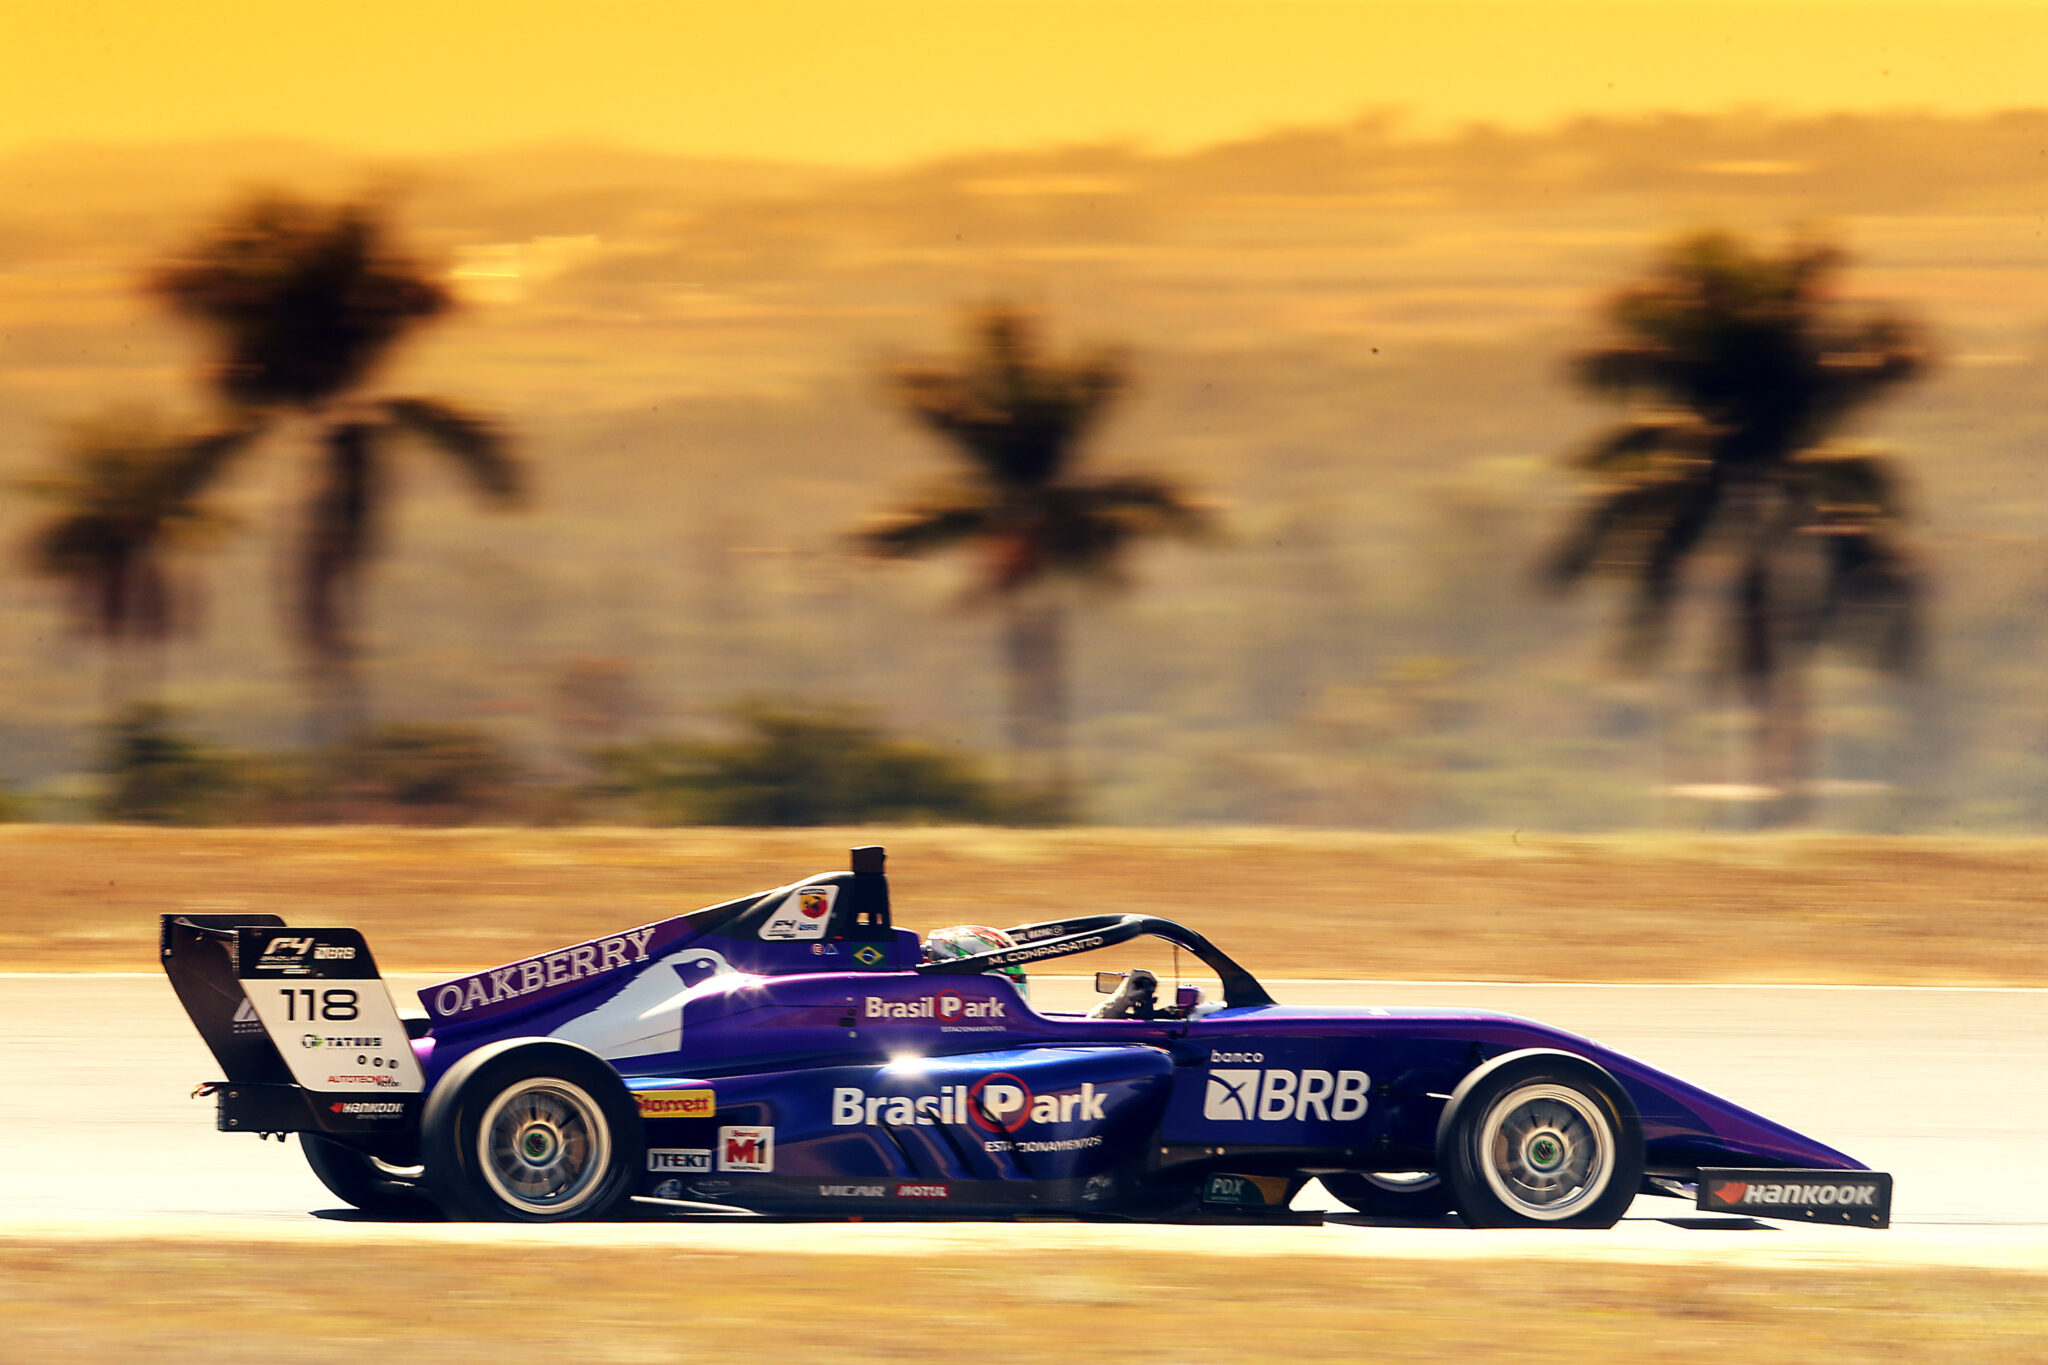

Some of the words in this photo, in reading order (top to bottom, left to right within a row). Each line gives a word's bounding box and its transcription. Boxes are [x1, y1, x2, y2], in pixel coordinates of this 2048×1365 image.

[263, 937, 315, 955] F4
[435, 927, 656, 1017] OAKBERRY
[280, 988, 358, 1021] 118
[865, 996, 935, 1018] Brasil
[940, 996, 1006, 1018] Park
[1211, 1050, 1264, 1063] banco
[832, 1086, 967, 1126] Brasil
[983, 1083, 1106, 1124] Park
[1258, 1069, 1371, 1122] BRB
[652, 1153, 711, 1169] JTEKT
[726, 1138, 767, 1164] M1
[819, 1185, 886, 1197] VICAR
[899, 1186, 948, 1197] MOTUL
[1211, 1178, 1245, 1195] PDX
